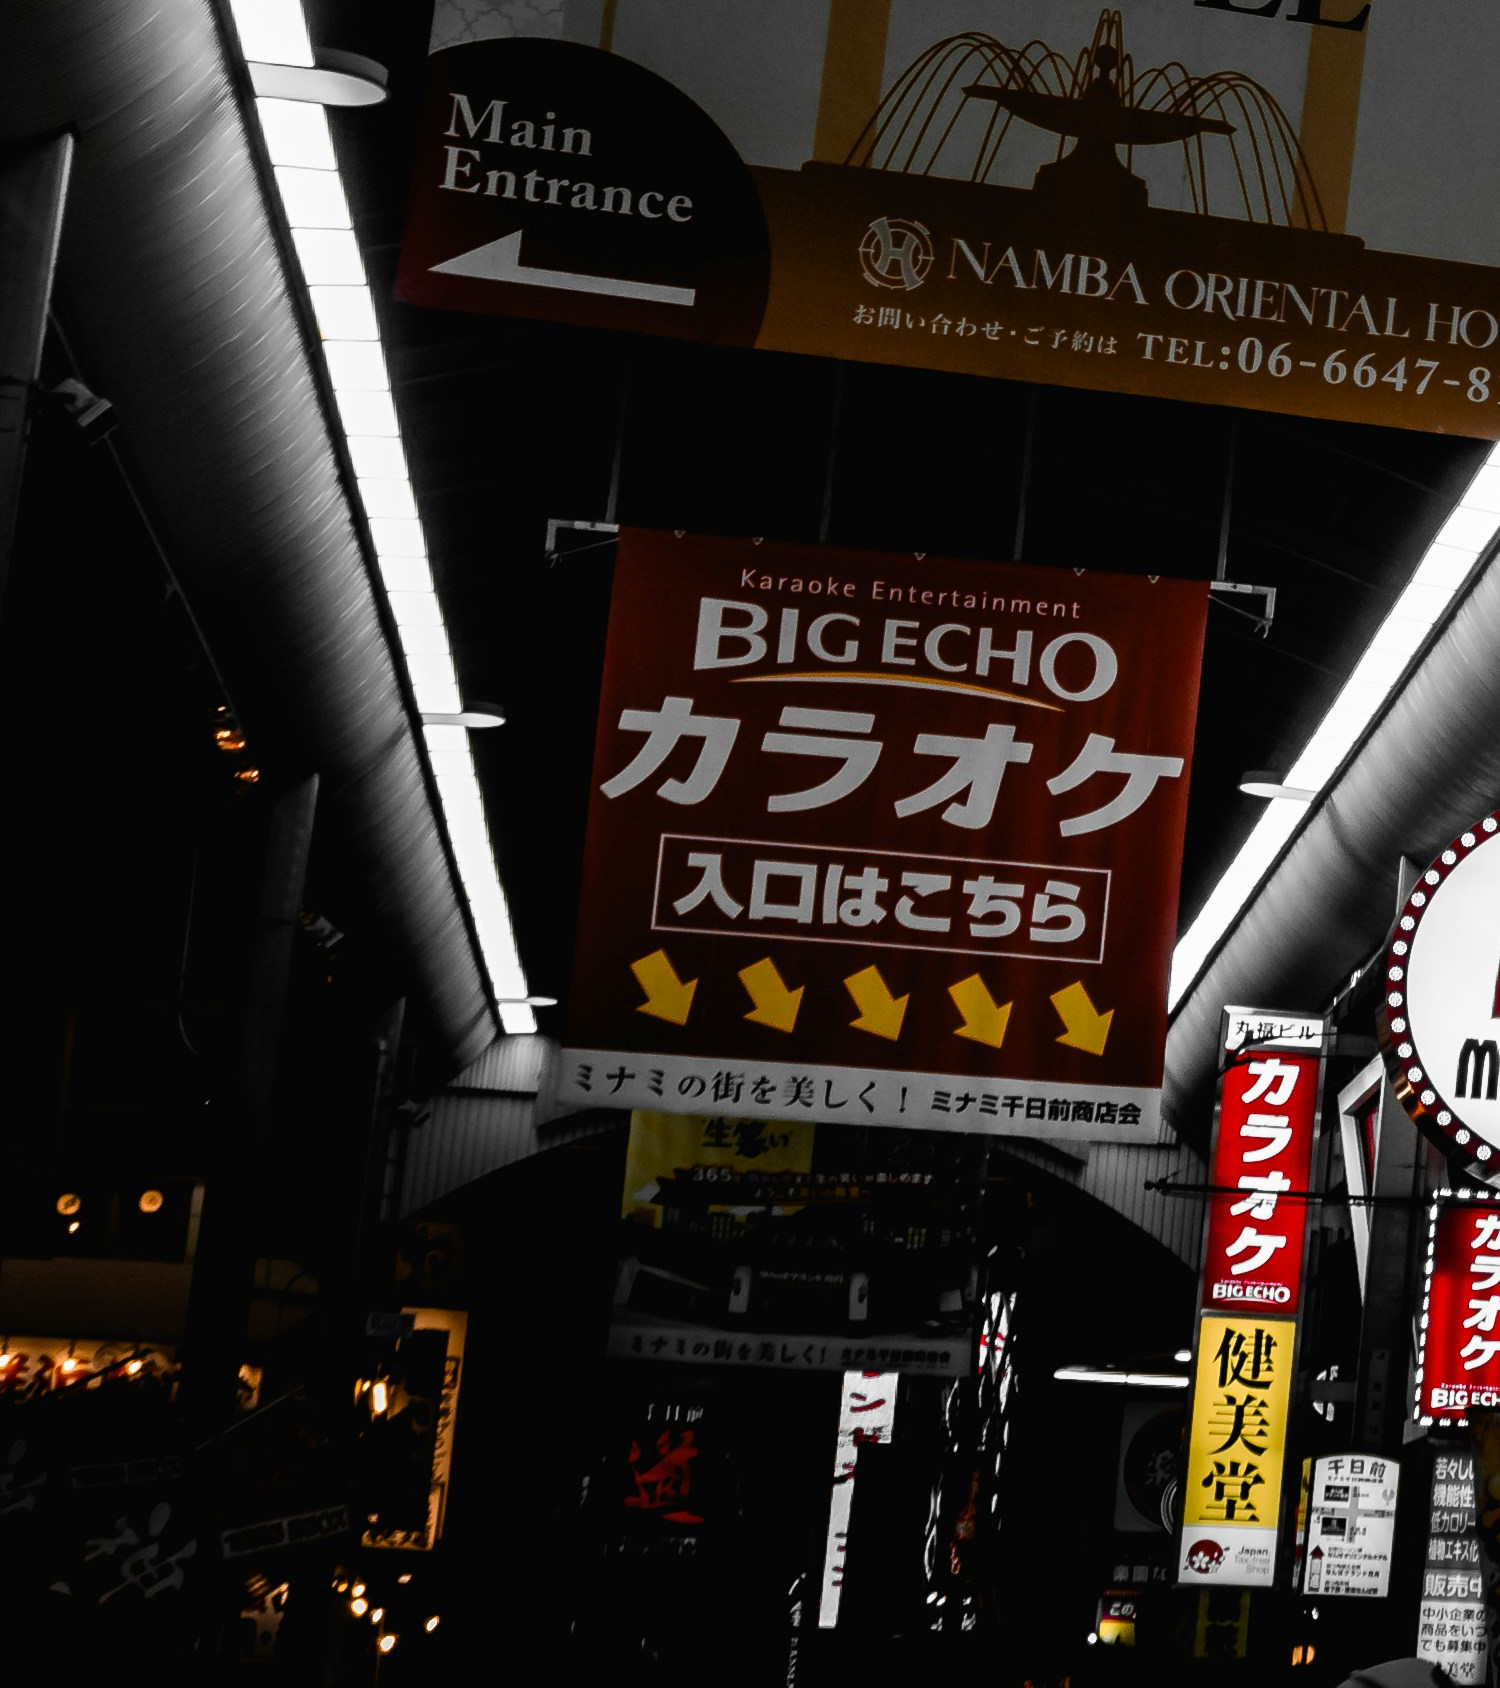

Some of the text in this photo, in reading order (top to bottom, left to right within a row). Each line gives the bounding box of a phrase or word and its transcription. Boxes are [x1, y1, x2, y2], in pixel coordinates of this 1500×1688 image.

[444, 92, 595, 159] Main
[437, 146, 695, 226] Entrance
[947, 238, 1149, 306] NAMBA
[1164, 268, 1412, 340] ORIENTAL
[740, 568, 1083, 621] Karaoke Entertainment
[693, 596, 1119, 703] BIG ECHO
[599, 696, 1185, 839] カラオケ
[673, 851, 1087, 944] 入口はこちら
[931, 1089, 1142, 1125] ミナミ千日前商店会
[1225, 1057, 1301, 1276] カラオケ
[1212, 1282, 1244, 1300] BIG
[1245, 1284, 1291, 1304] ECHO
[1203, 1326, 1278, 1524] 健美堂
[1431, 1387, 1469, 1409] BIG
